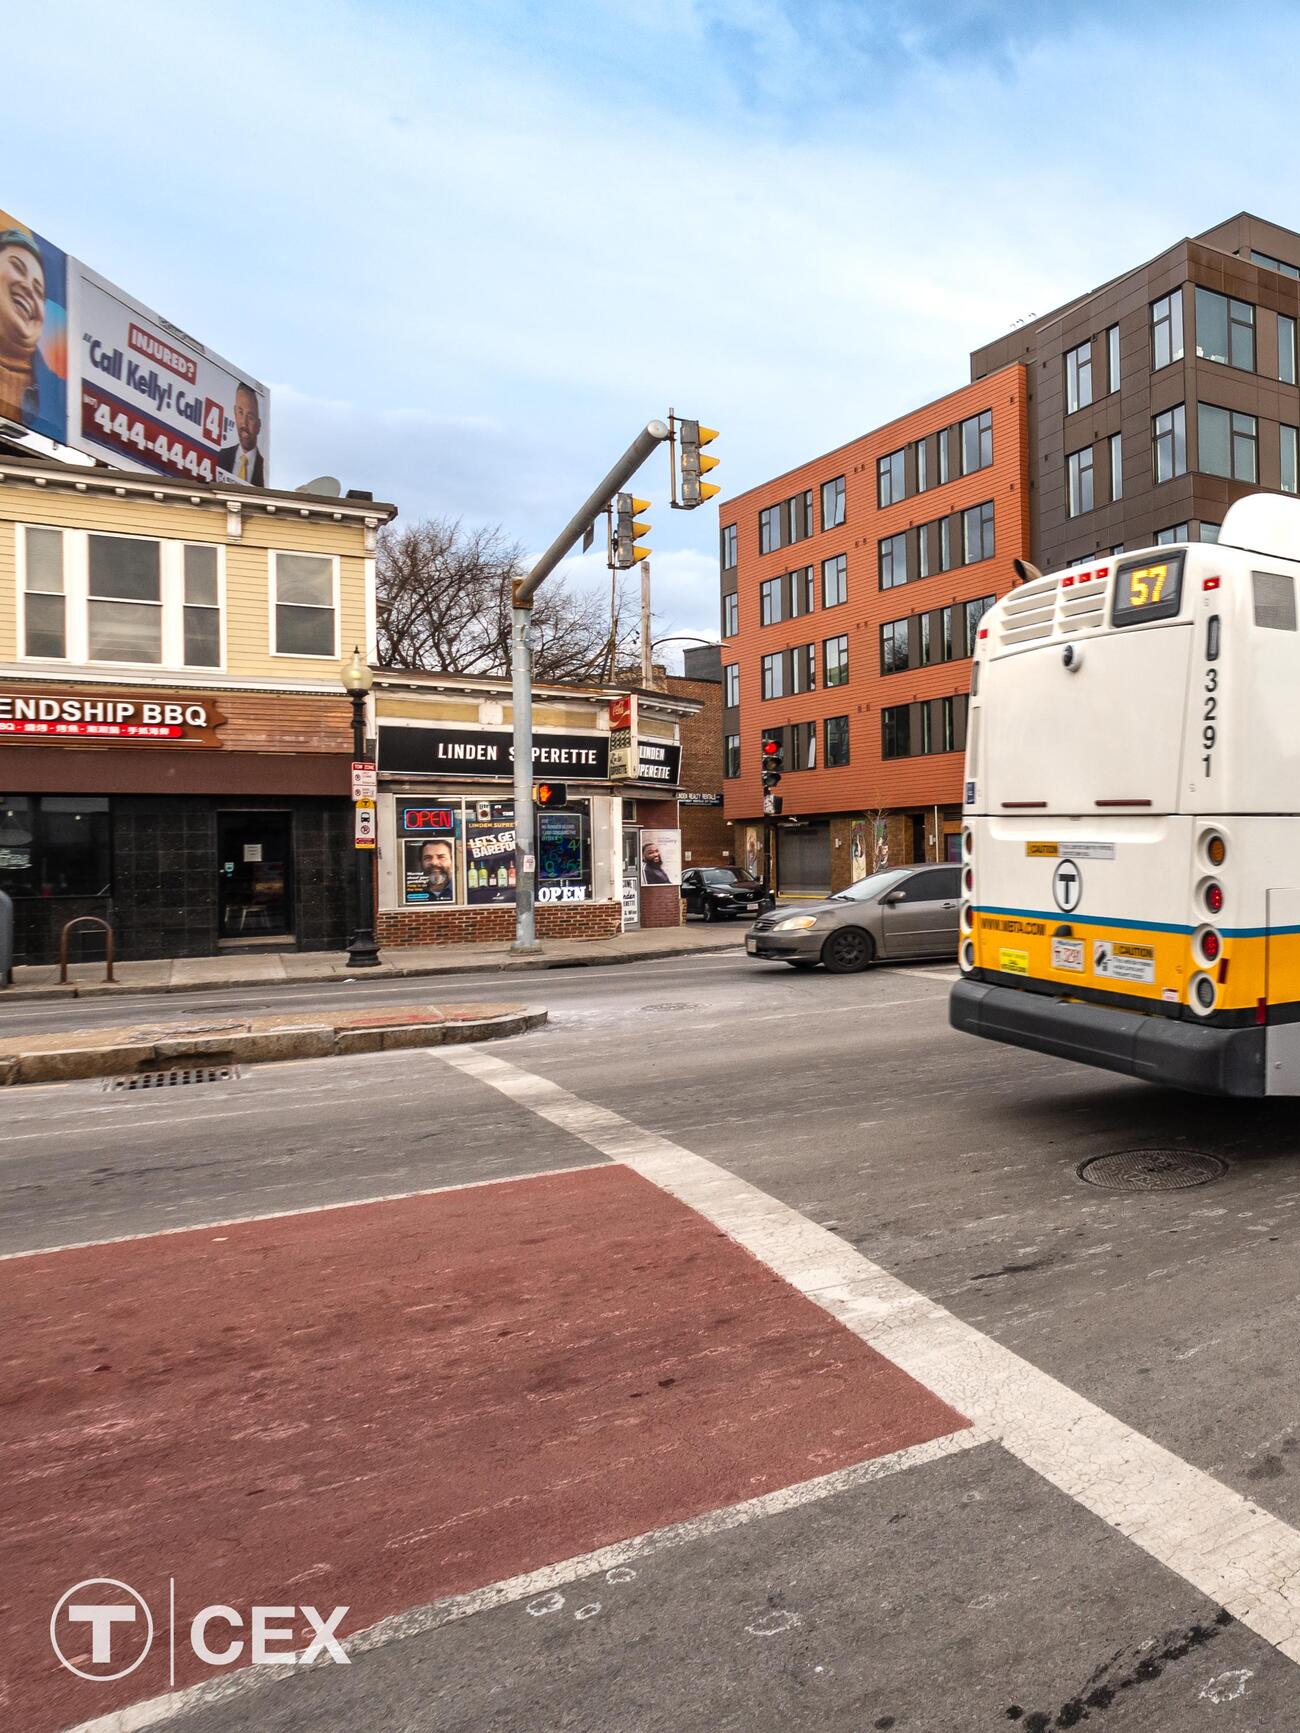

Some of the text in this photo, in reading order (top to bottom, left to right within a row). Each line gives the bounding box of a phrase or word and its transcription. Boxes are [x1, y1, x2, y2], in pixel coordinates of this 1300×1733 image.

[131, 328, 195, 378] INJURED?
[127, 359, 172, 412] Kelly!
[175, 390, 202, 427] Call
[94, 403, 213, 483] 444-4444
[1130, 564, 1168, 606] 57
[143, 704, 207, 727] BBQ
[1201, 668, 1218, 778] 3291
[438, 743, 497, 760] LINDEN
[508, 746, 597, 764] SPERETTE
[640, 745, 665, 761] LINDEN
[639, 763, 671, 779] PERETTE
[406, 811, 451, 829] OPEN
[539, 886, 587, 902] OPEN
[1058, 873, 1076, 905] T
[981, 917, 1047, 936] WWW.MBTA.COM
[1119, 945, 1154, 958] CAUTION
